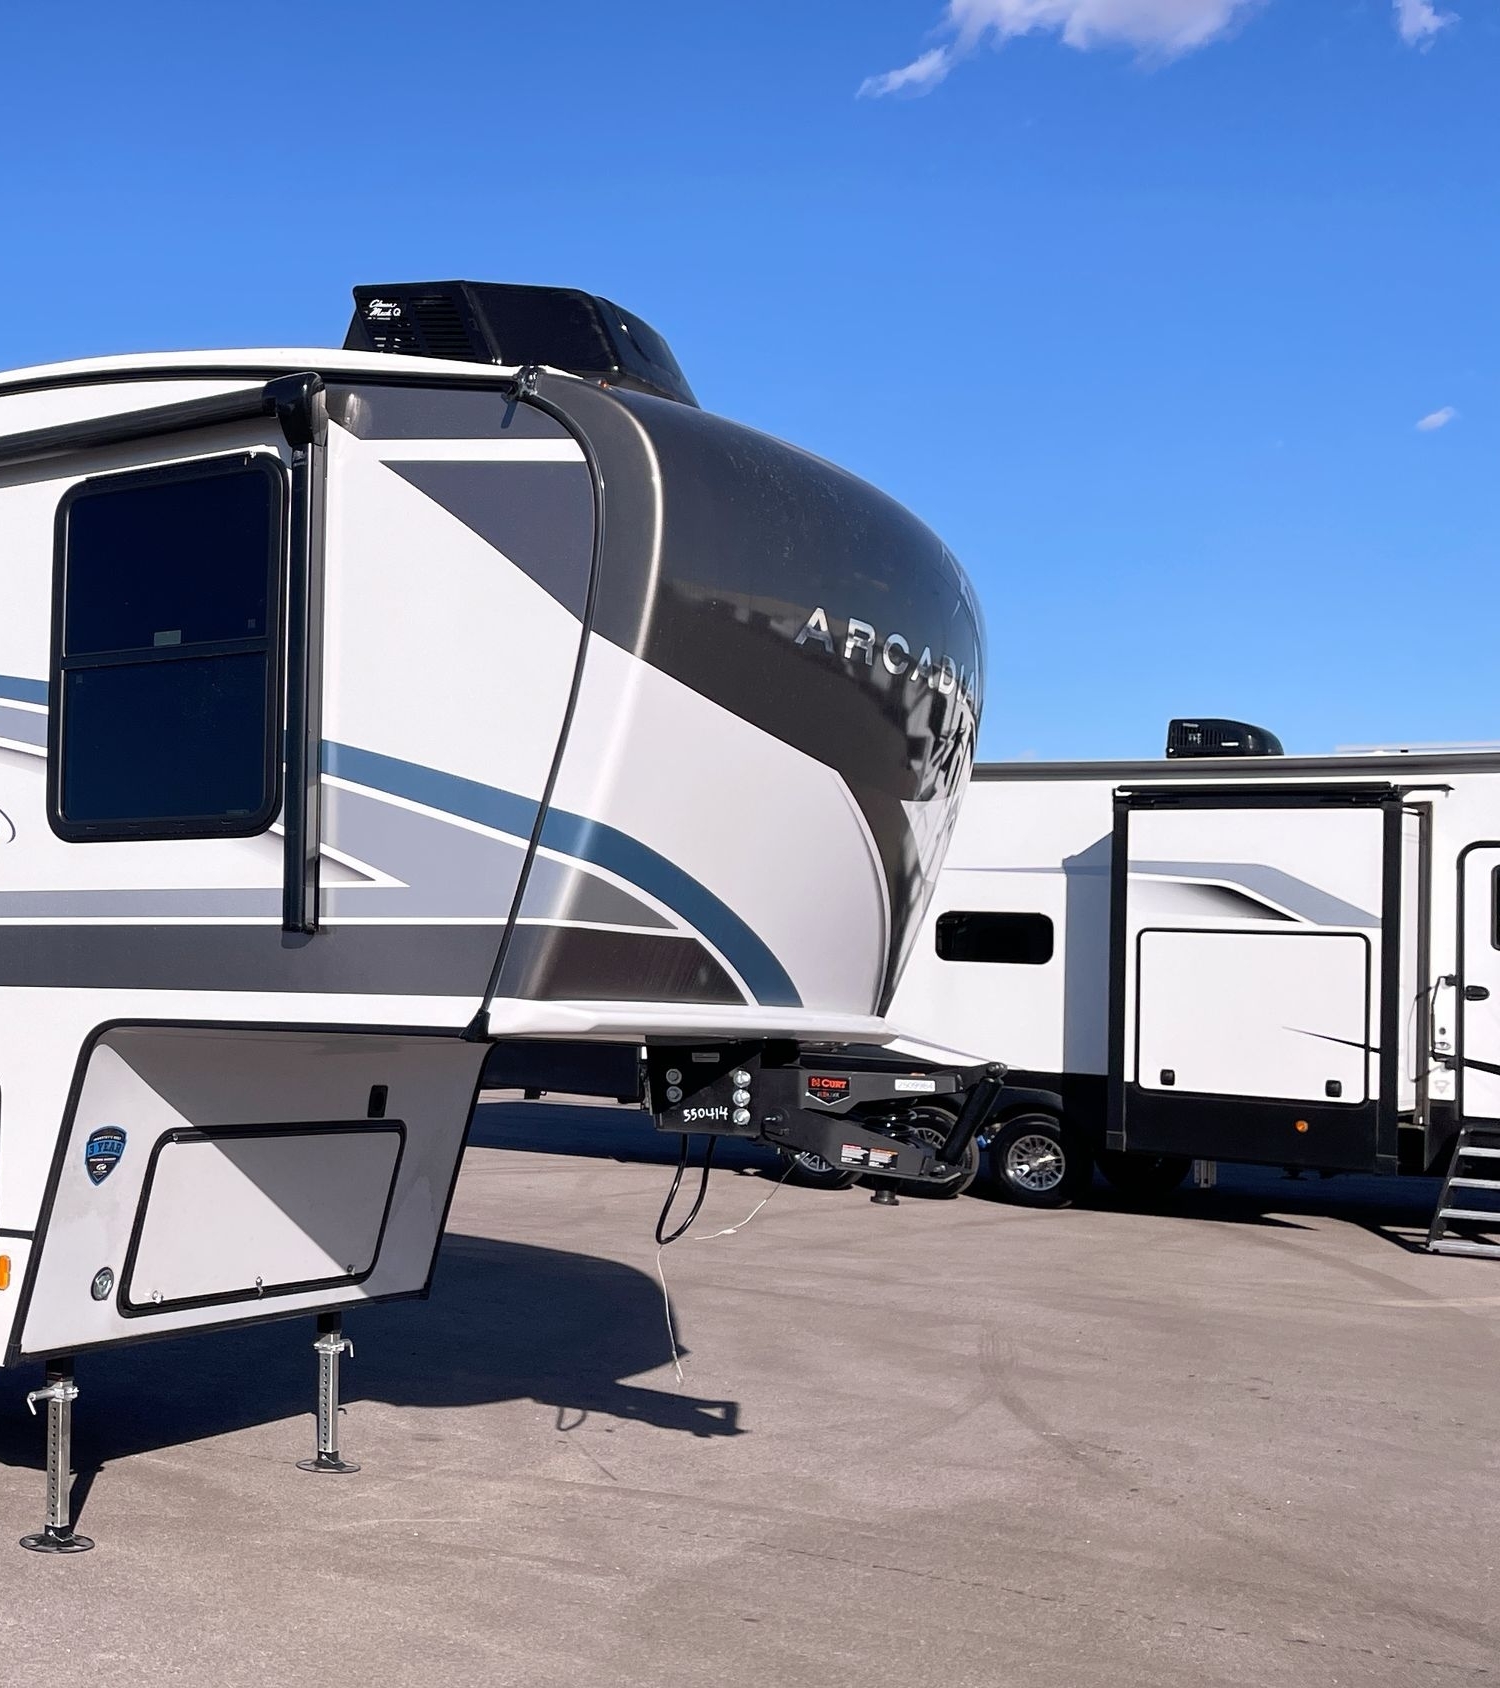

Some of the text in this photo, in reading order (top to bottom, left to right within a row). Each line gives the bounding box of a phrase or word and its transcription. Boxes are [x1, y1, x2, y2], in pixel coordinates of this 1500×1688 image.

[794, 607, 976, 703] ARCADIA
[821, 1079, 847, 1089] CURT
[683, 1105, 729, 1123] 550414
[97, 1141, 122, 1154] YEAR
